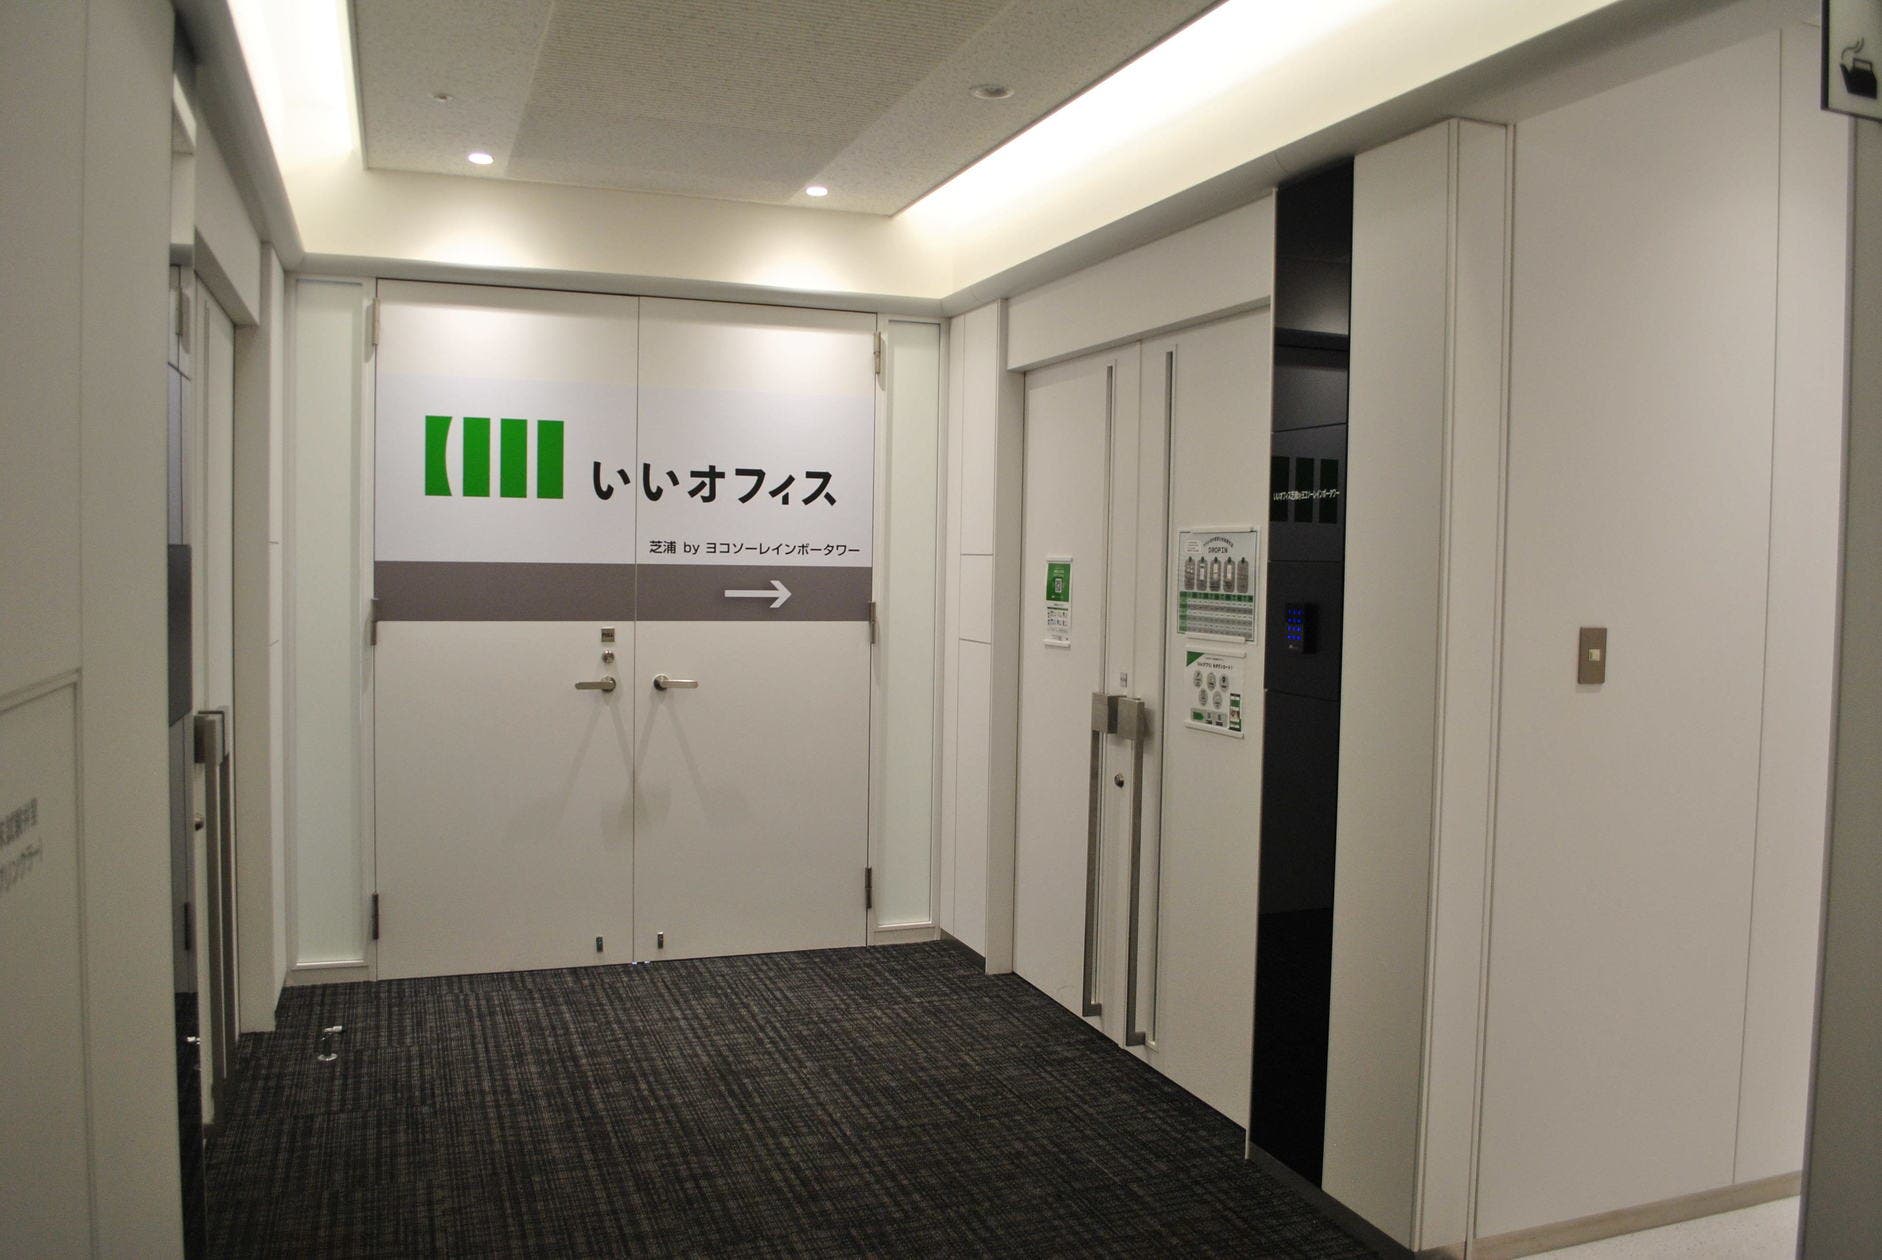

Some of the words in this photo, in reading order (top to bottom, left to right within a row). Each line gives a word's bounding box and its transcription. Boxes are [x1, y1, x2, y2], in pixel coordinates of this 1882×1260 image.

[593, 461, 837, 506] いいオフィス
[649, 540, 677, 555] 芝浦
[683, 542, 700, 556] by
[705, 542, 861, 557] ヨコソーレインボータワー
